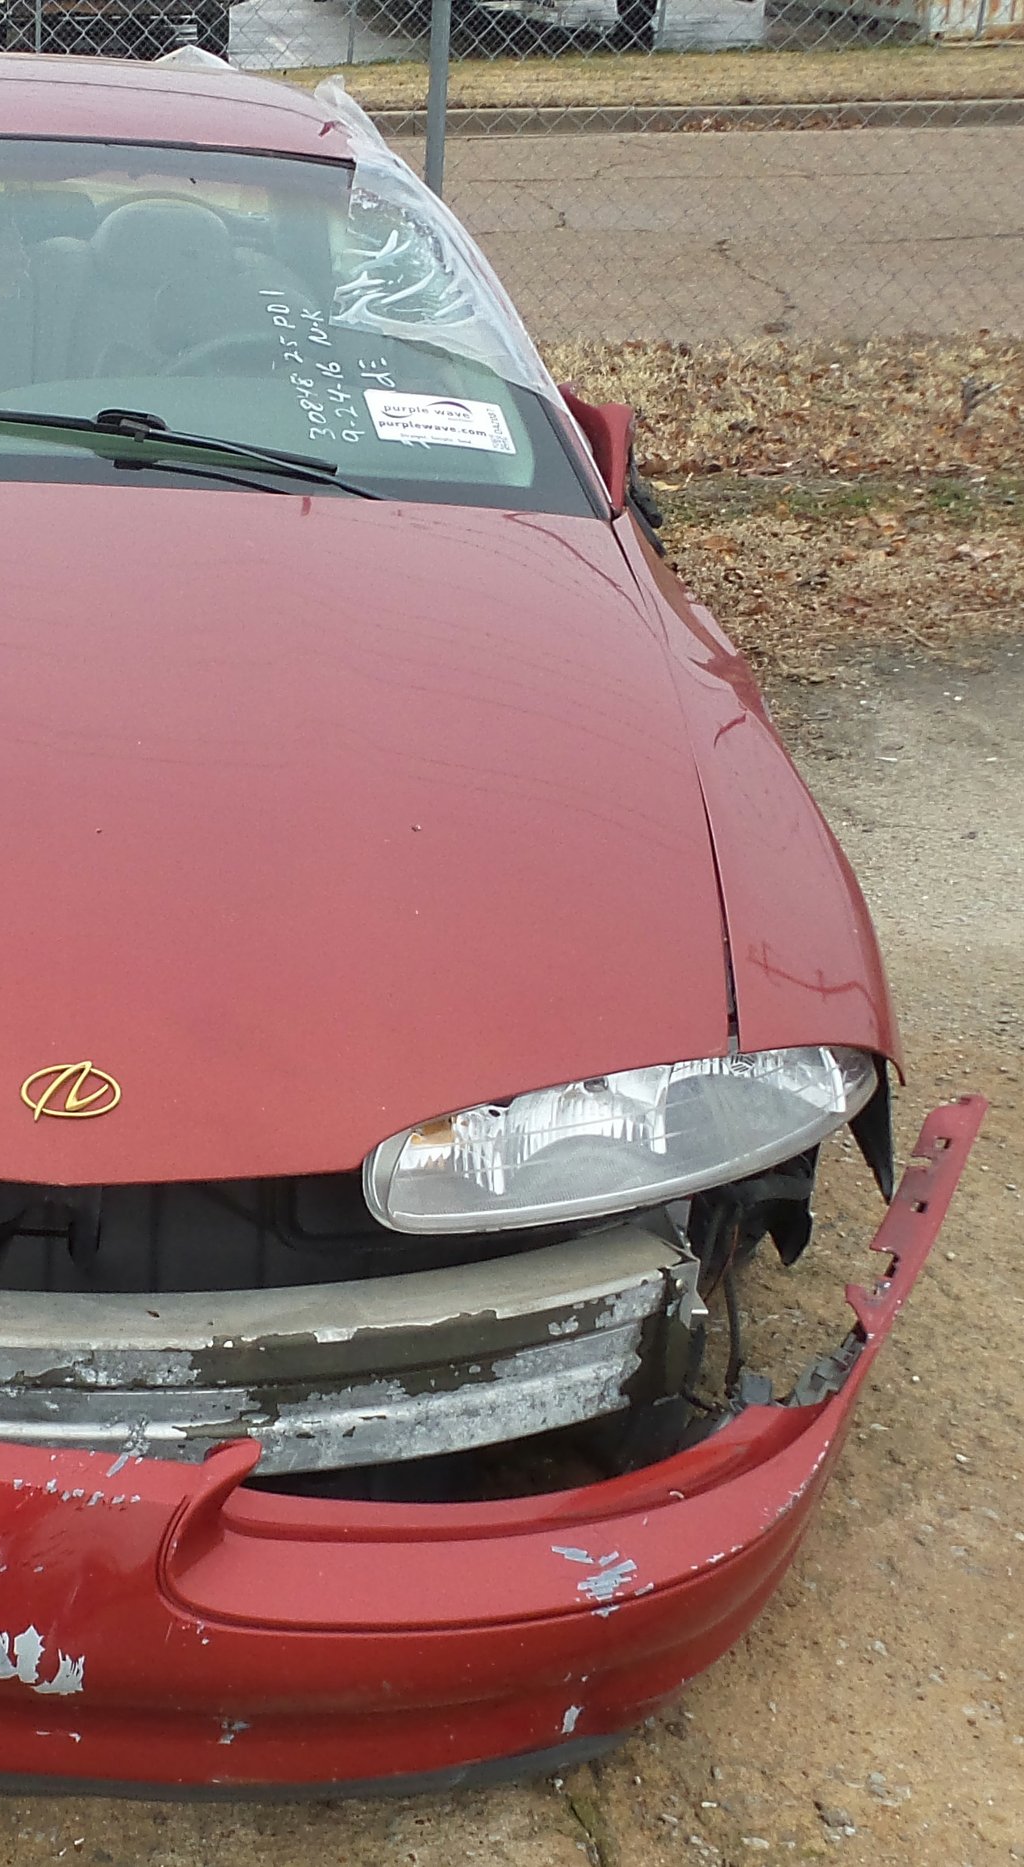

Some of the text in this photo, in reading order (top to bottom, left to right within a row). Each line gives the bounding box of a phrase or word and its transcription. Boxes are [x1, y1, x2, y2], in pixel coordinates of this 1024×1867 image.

[383, 404, 471, 419] purple wave
[378, 420, 487, 437] purplewave.com
